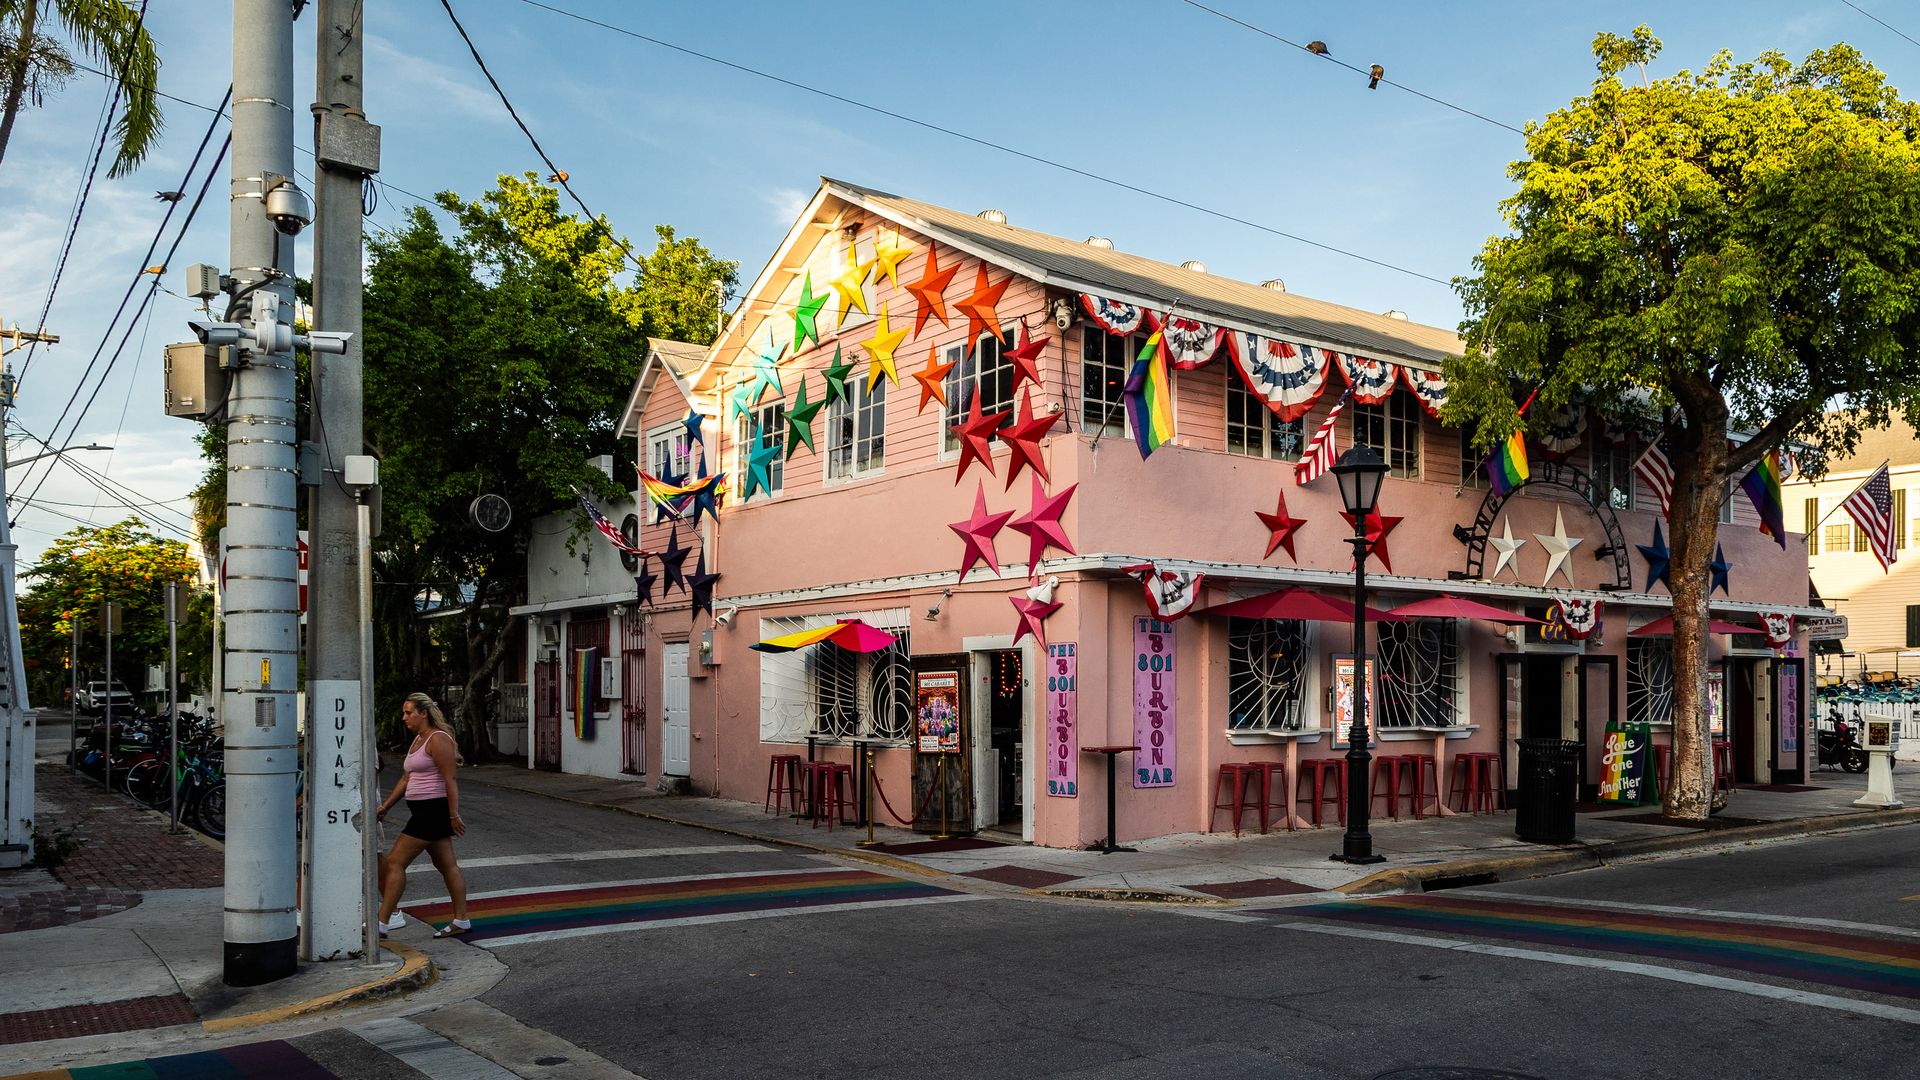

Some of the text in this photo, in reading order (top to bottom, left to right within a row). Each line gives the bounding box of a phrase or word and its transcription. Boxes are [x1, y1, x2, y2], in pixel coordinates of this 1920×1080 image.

[1139, 618, 1172, 634] THE
[1049, 643, 1075, 658] THE
[1138, 653, 1172, 672] 801
[1048, 675, 1075, 692] 801
[1147, 634, 1168, 766] BOURBON
[1056, 658, 1072, 777] BOURBON
[1603, 734, 1643, 764] Love
[327, 698, 350, 824] DUVAL ST
[1611, 760, 1633, 772] one
[1138, 768, 1173, 784] BAR
[1048, 780, 1076, 796] BAR
